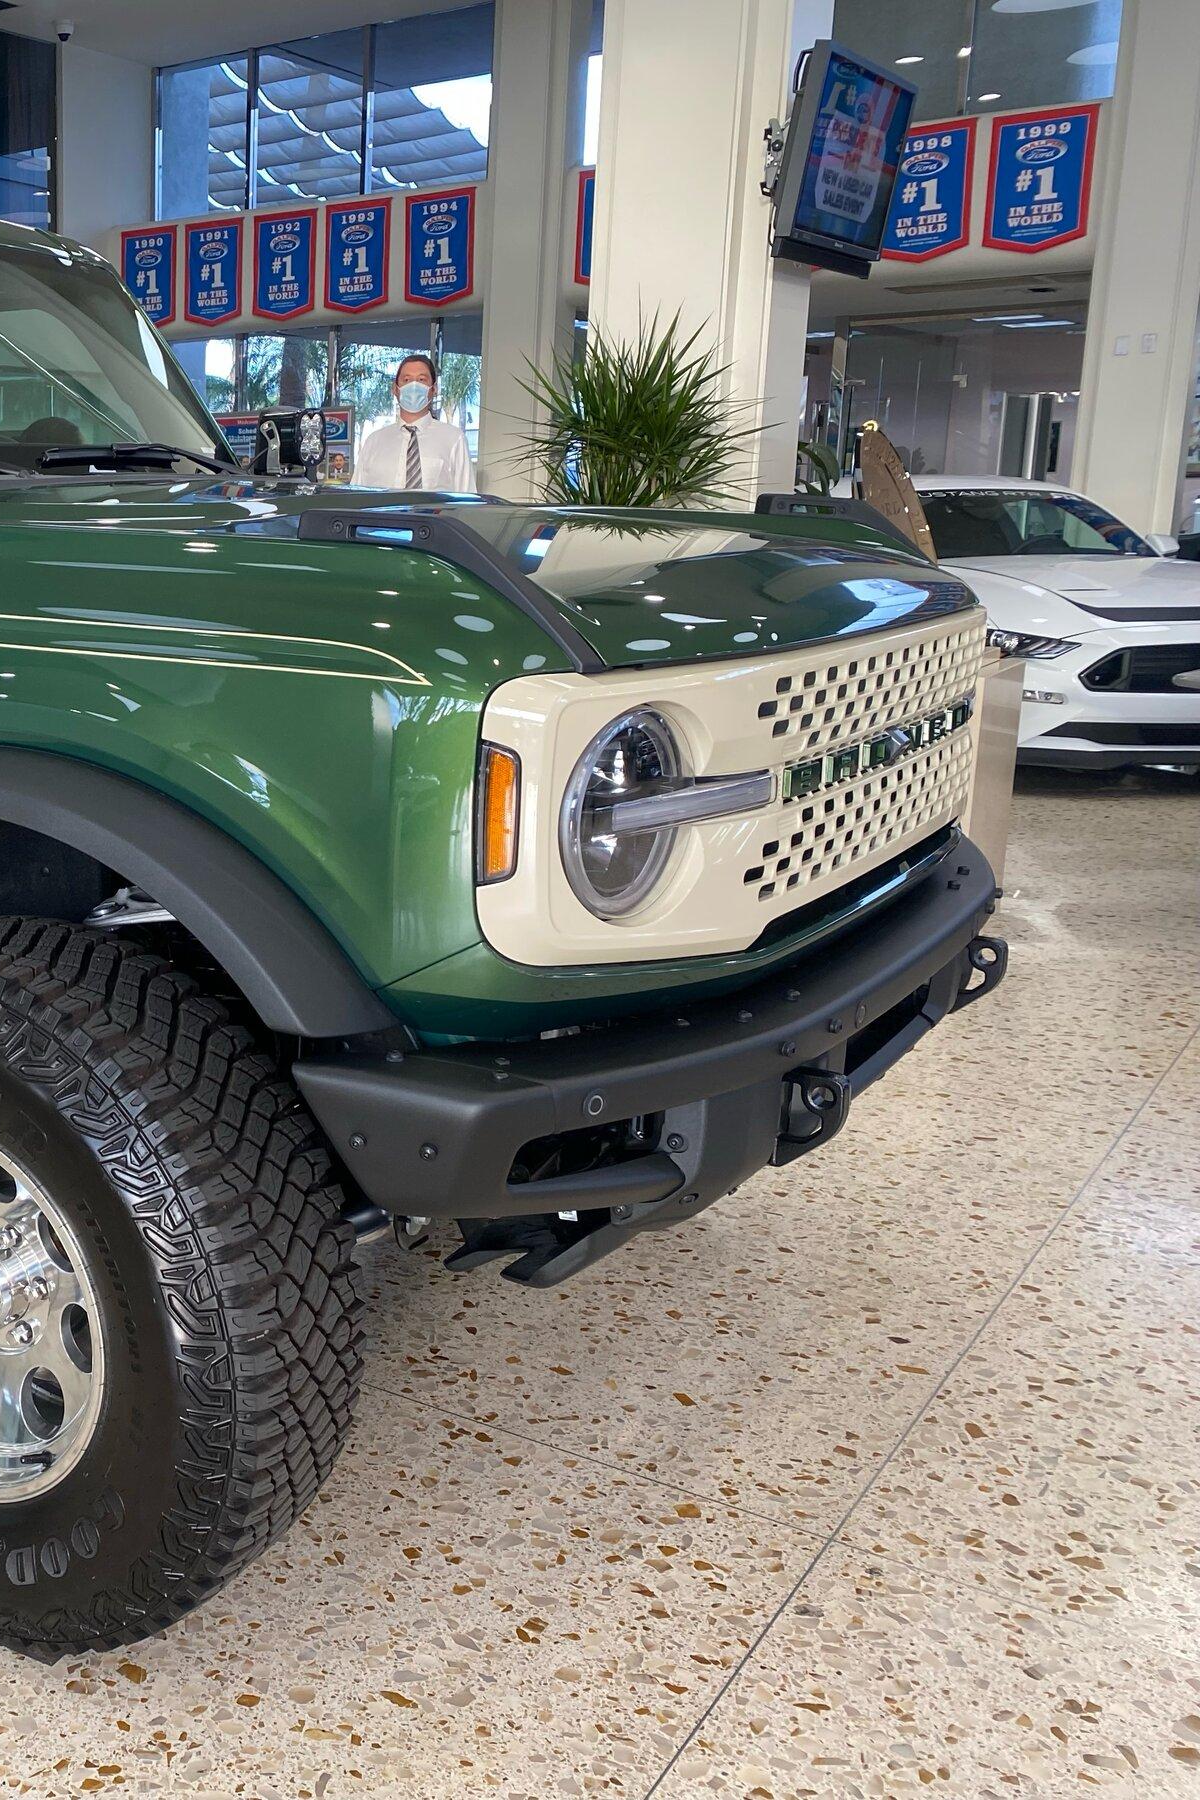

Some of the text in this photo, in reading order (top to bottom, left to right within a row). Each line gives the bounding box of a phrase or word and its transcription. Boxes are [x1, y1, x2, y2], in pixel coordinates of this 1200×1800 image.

[1016, 122, 1072, 140] 1999
[904, 135, 952, 153] 1998
[1015, 166, 1058, 201] #1
[902, 178, 942, 212] #1
[422, 201, 458, 216] 1994
[1008, 202, 1063, 217] IN THE
[341, 212, 375, 224] 1993
[897, 212, 948, 228] IN THE
[1007, 212, 1064, 228] WORLD
[270, 222, 300, 234] 1992
[896, 222, 948, 238] WORLD
[200, 230, 229, 242] 1991
[134, 237, 164, 249] 1990
[424, 236, 452, 265] #1
[342, 246, 369, 273] #1
[271, 255, 295, 281] #1
[420, 266, 457, 278] IN THE
[201, 262, 224, 288] #1
[339, 274, 373, 286] IN THE
[420, 274, 457, 286] WORLD
[136, 269, 159, 294] #1
[281, 282, 299, 292] THE
[339, 283, 373, 293] WORLD
[145, 295, 162, 304] THE
[197, 290, 228, 300] IN THE
[268, 291, 300, 301] WORLD
[142, 303, 162, 312] ORLD
[196, 297, 228, 307] WORLD
[918, 490, 1000, 498] USTANG
